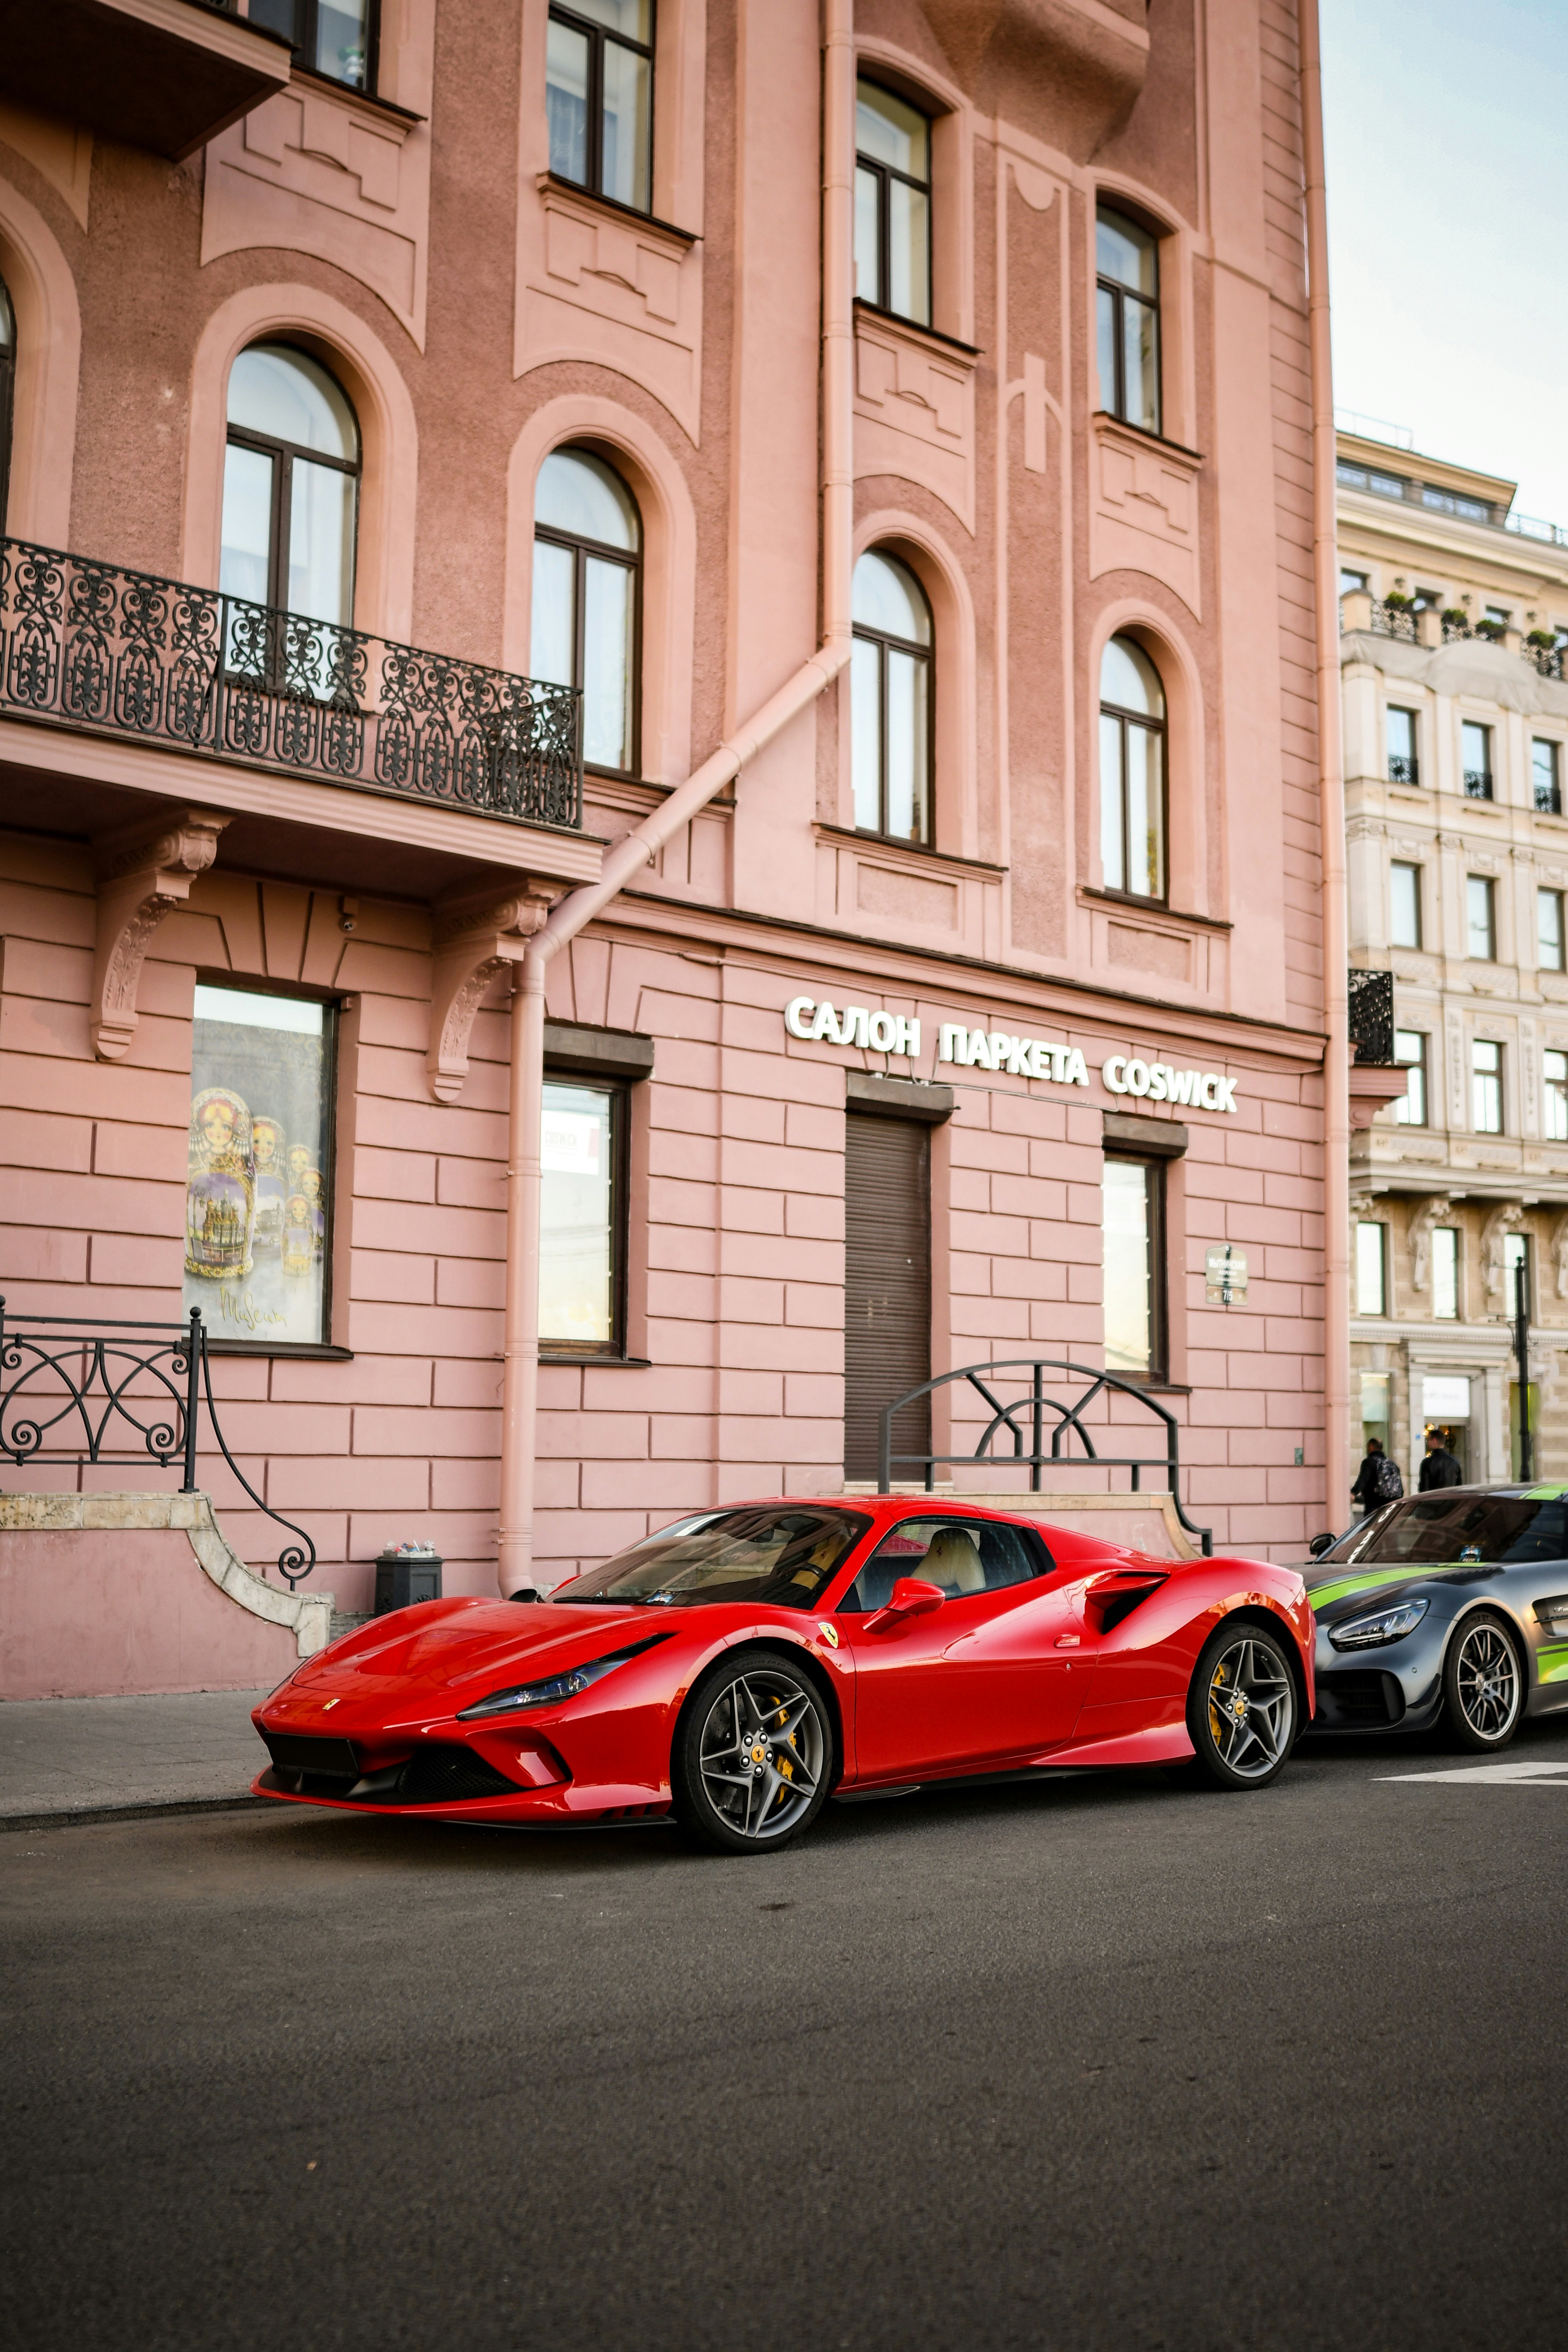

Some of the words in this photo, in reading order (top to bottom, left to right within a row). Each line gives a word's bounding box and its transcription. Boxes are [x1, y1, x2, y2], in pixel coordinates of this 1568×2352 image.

[785, 996, 920, 1056] САЛОН
[939, 1024, 1090, 1086] ПАРКЕТА
[1102, 1056, 1238, 1113] COSWICK
[1223, 1290, 1233, 1301] 7/5
